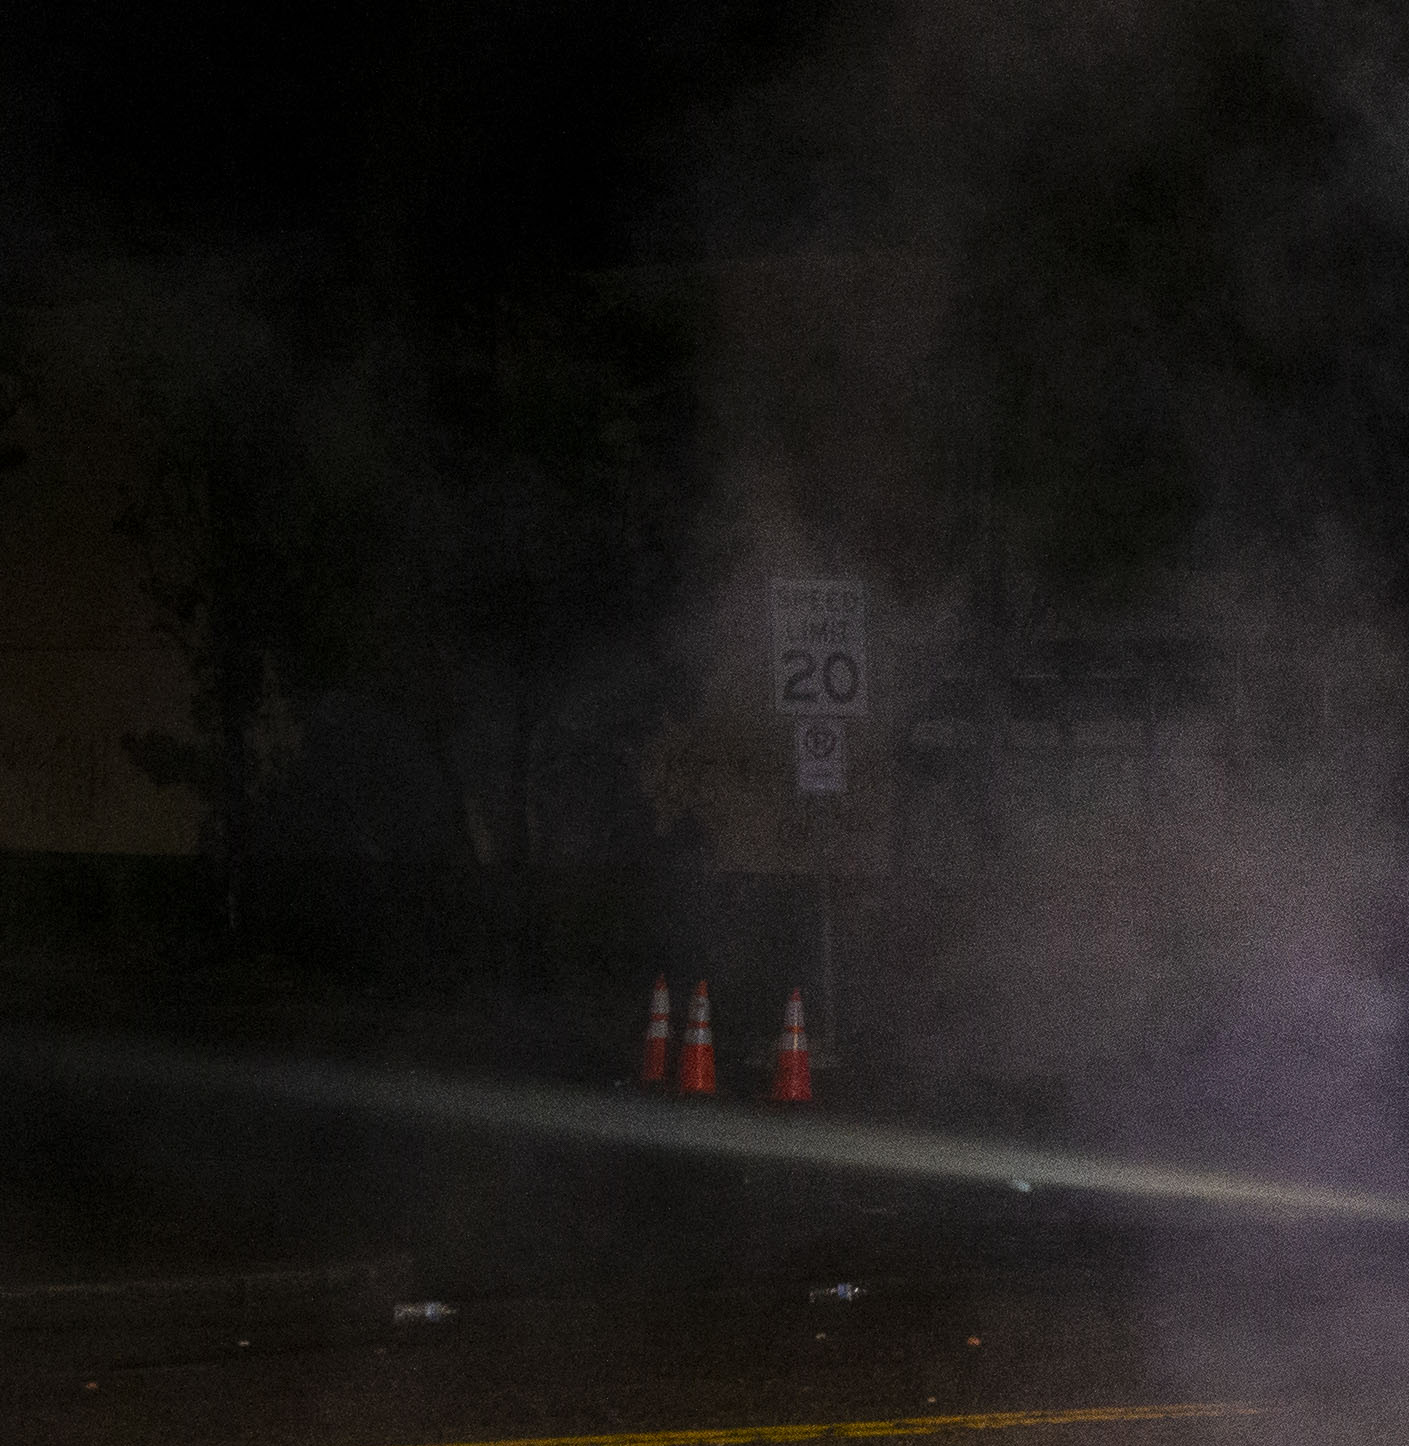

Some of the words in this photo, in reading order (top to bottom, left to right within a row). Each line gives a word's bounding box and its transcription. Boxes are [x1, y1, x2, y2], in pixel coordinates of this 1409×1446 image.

[777, 588, 858, 612] SPEED
[787, 619, 848, 642] LIMIT
[782, 650, 858, 703] 20
